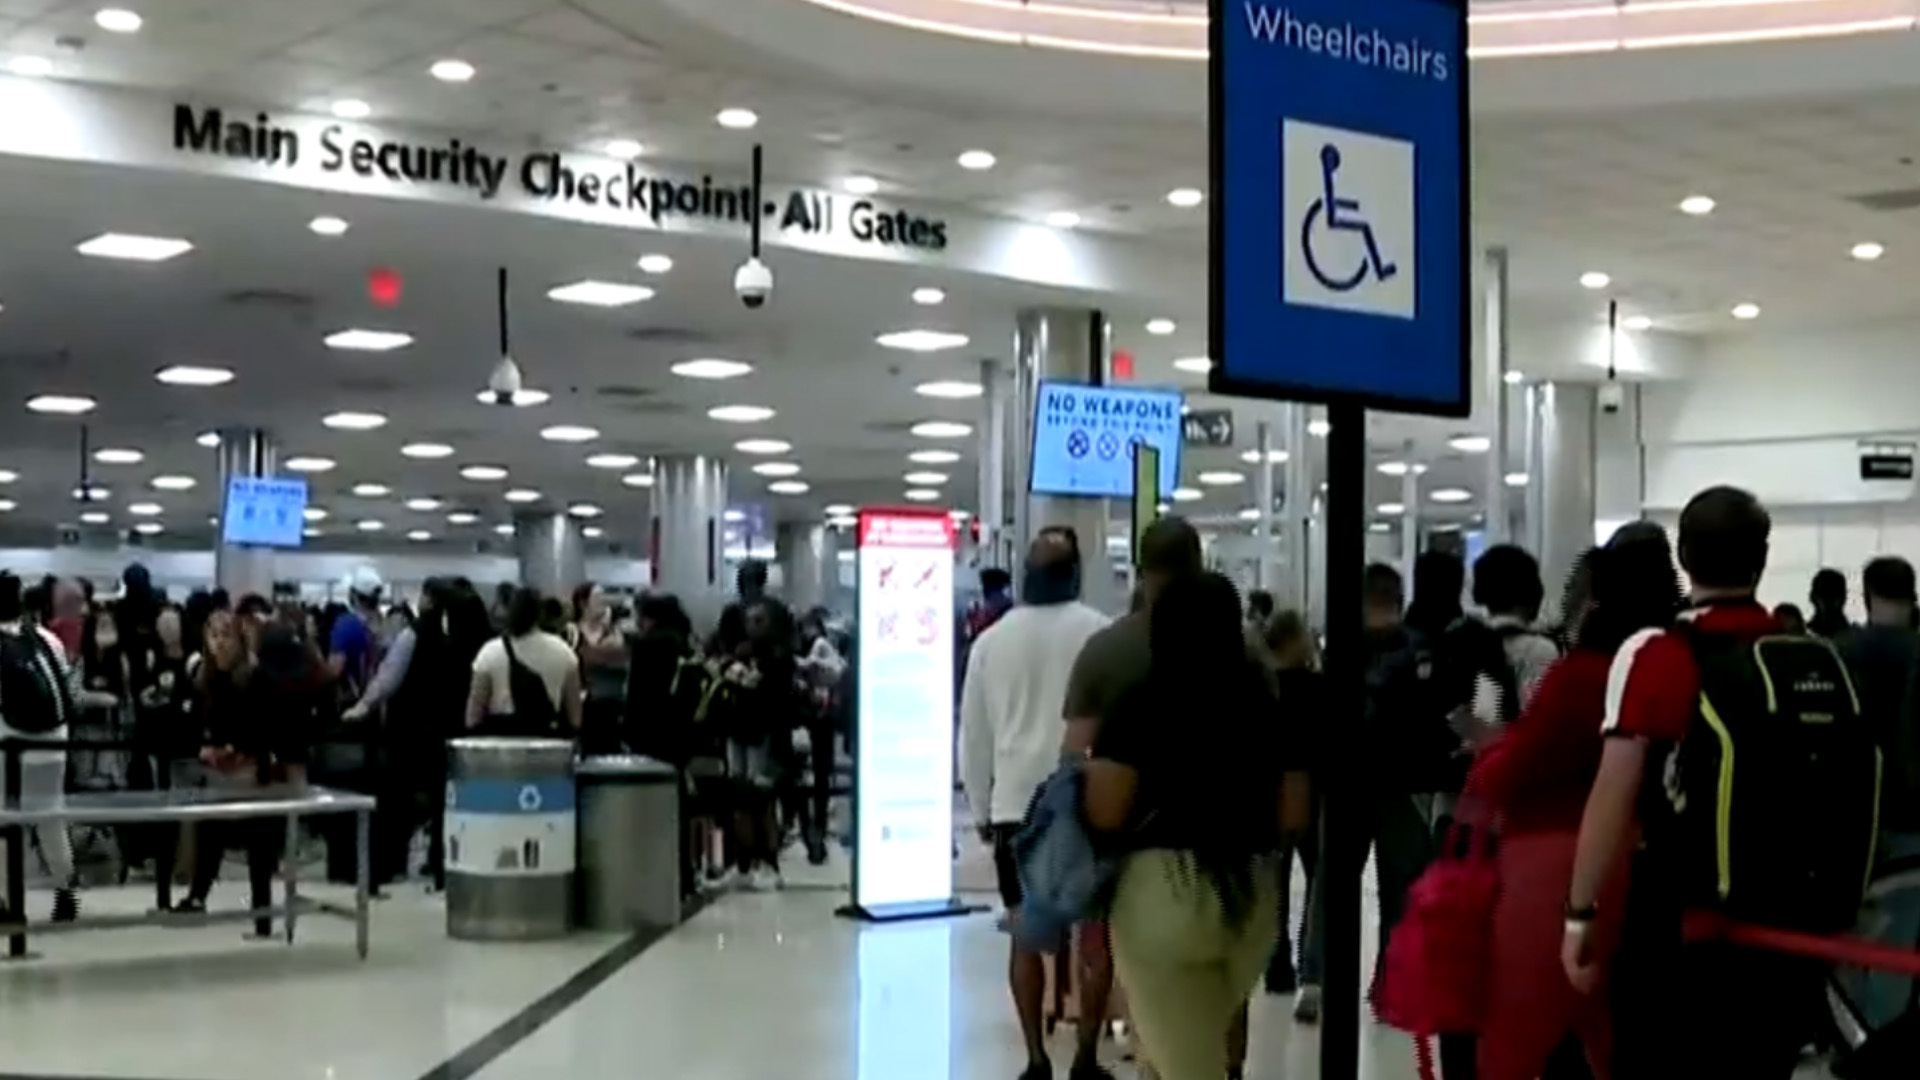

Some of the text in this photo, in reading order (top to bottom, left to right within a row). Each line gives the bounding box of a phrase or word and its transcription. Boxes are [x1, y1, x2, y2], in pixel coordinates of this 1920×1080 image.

[1244, 1, 1448, 81] Wheelchairs
[173, 104, 298, 168] Main
[320, 125, 508, 199] Security
[519, 152, 752, 224] Checkpoint
[779, 190, 834, 235] All
[848, 201, 948, 249] Gates
[1047, 392, 1173, 420] NO WEAPONS
